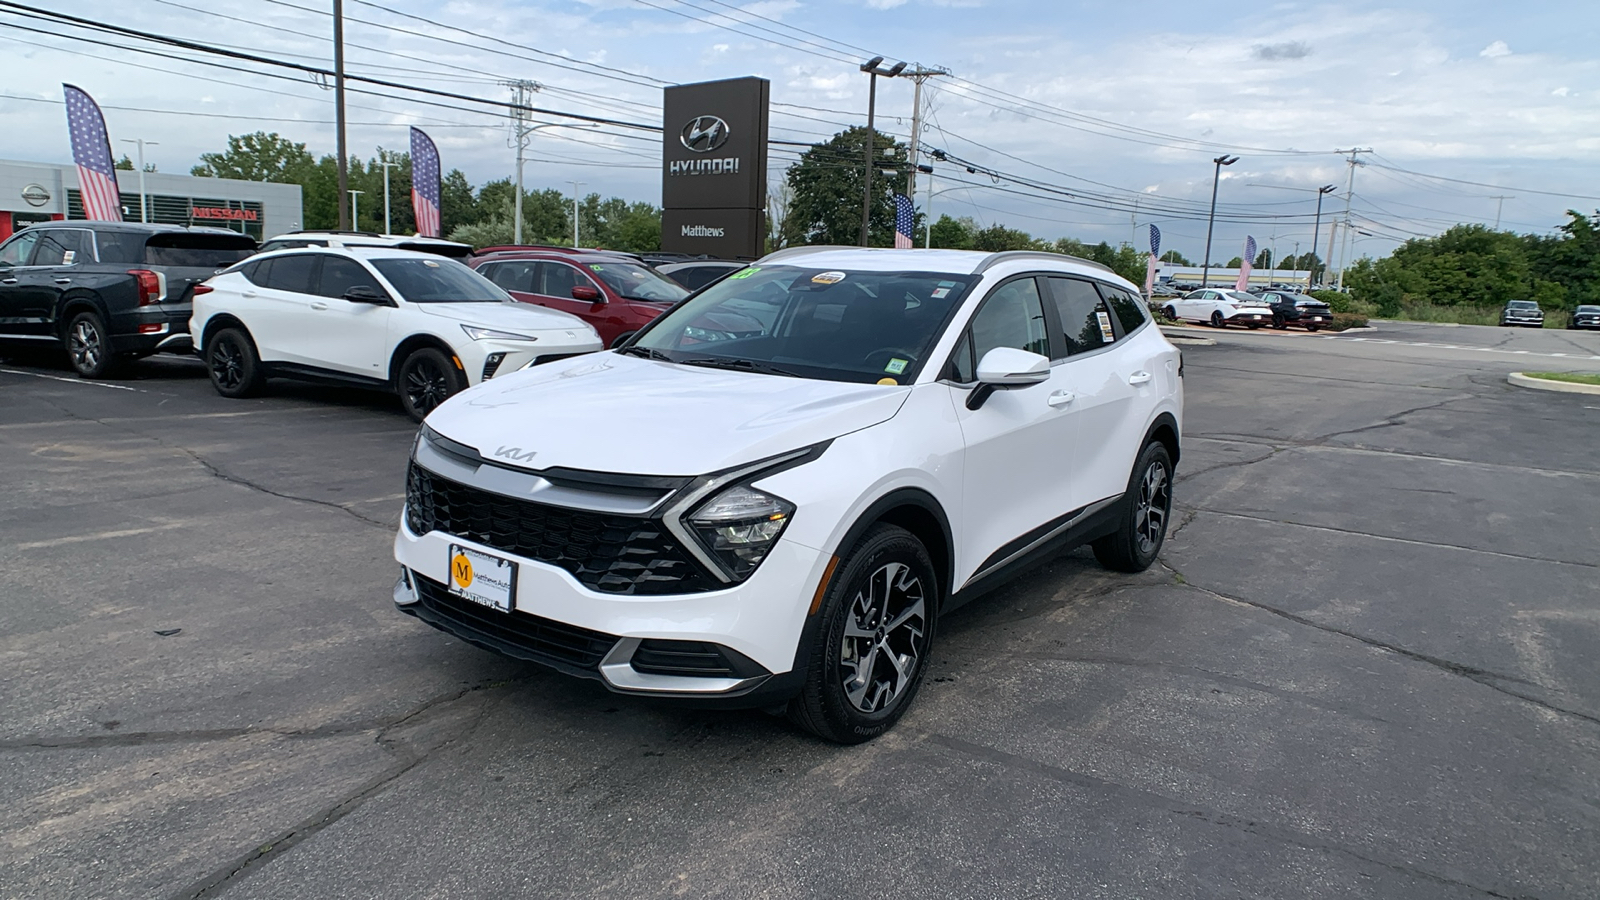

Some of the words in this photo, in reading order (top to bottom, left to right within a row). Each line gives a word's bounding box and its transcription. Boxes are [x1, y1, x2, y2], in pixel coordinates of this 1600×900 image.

[670, 157, 739, 176] HYUNDAI
[192, 206, 257, 220] NISSAN
[681, 225, 724, 237] Matthews
[494, 445, 538, 463] KIA
[455, 562, 469, 582] M
[473, 571, 497, 585] Matthews
[461, 590, 496, 610] MATTHEWS
